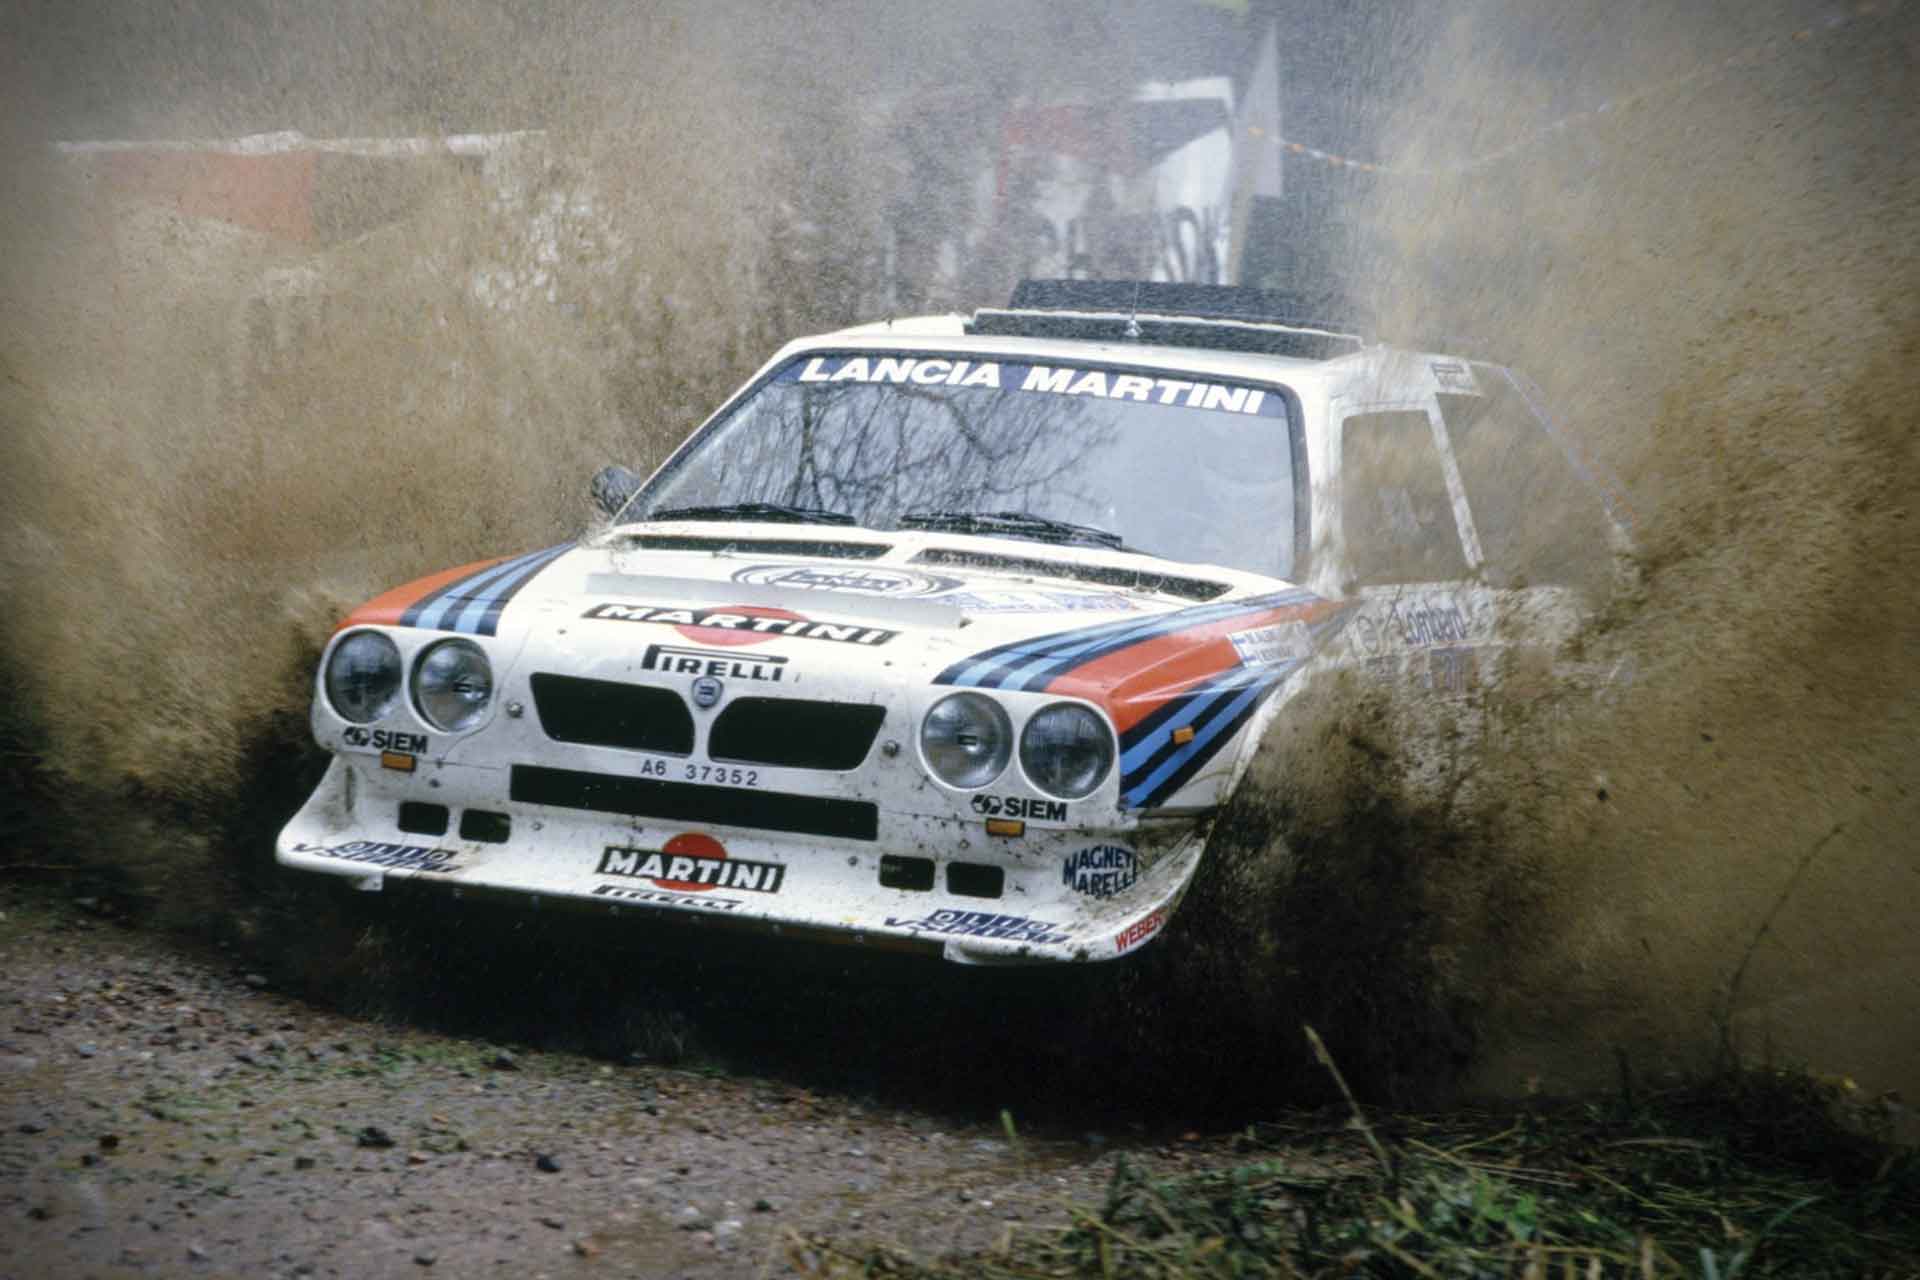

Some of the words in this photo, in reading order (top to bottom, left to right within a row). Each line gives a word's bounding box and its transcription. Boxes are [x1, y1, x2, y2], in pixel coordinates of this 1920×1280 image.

[799, 357, 1000, 388] LANCIA
[1020, 365, 1265, 414] MARTINI
[596, 604, 885, 647] MARTINI
[641, 643, 789, 682] PIRELLI
[372, 729, 429, 753] SIEM
[640, 758, 667, 776] A6
[685, 763, 759, 787] 37352
[1003, 799, 1068, 822] SIEM
[603, 848, 778, 891] MARTINI
[1062, 844, 1137, 885] MAGNETI
[1072, 867, 1137, 900] MARELLI
[1114, 906, 1169, 953] WEBER
